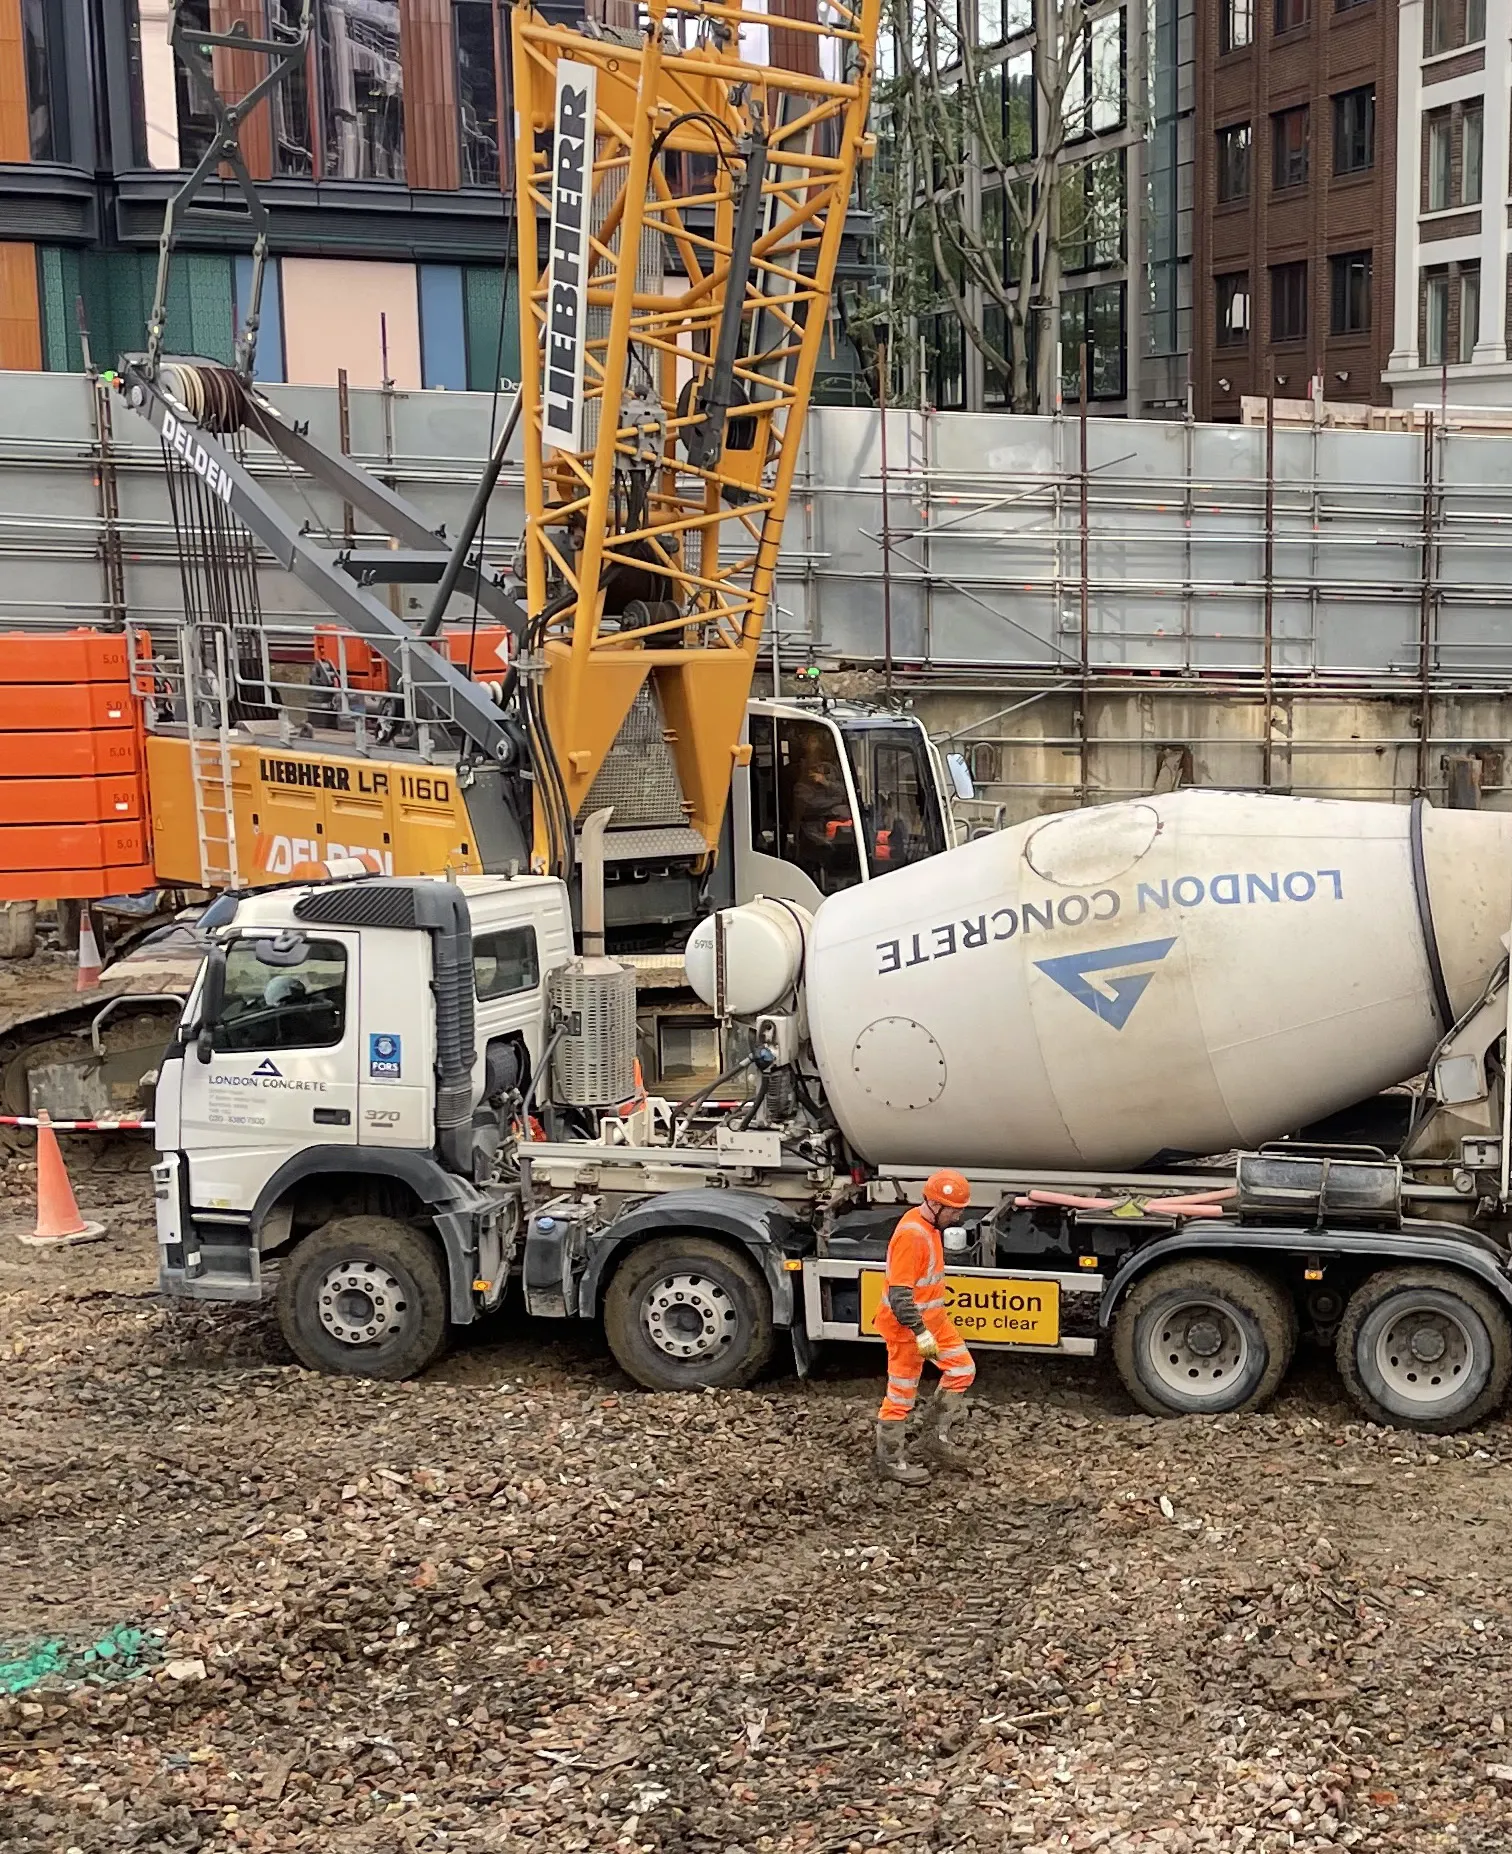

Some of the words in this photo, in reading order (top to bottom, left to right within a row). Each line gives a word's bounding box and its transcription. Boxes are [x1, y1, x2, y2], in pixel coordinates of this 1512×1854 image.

[547, 83, 588, 434] LIEBHERR
[162, 410, 234, 504] DELDEN
[260, 759, 351, 791] LIEBHERR
[401, 775, 449, 802] 1160
[1137, 869, 1344, 913] LONDON
[876, 889, 1121, 975] CONCRETE
[208, 1075, 258, 1087] LONDON
[262, 1078, 327, 1092] CONCRETE
[364, 1110, 401, 1122] 370
[943, 1285, 1042, 1312] Caution
[947, 1312, 987, 1330] eep
[993, 1314, 1039, 1330] clear
